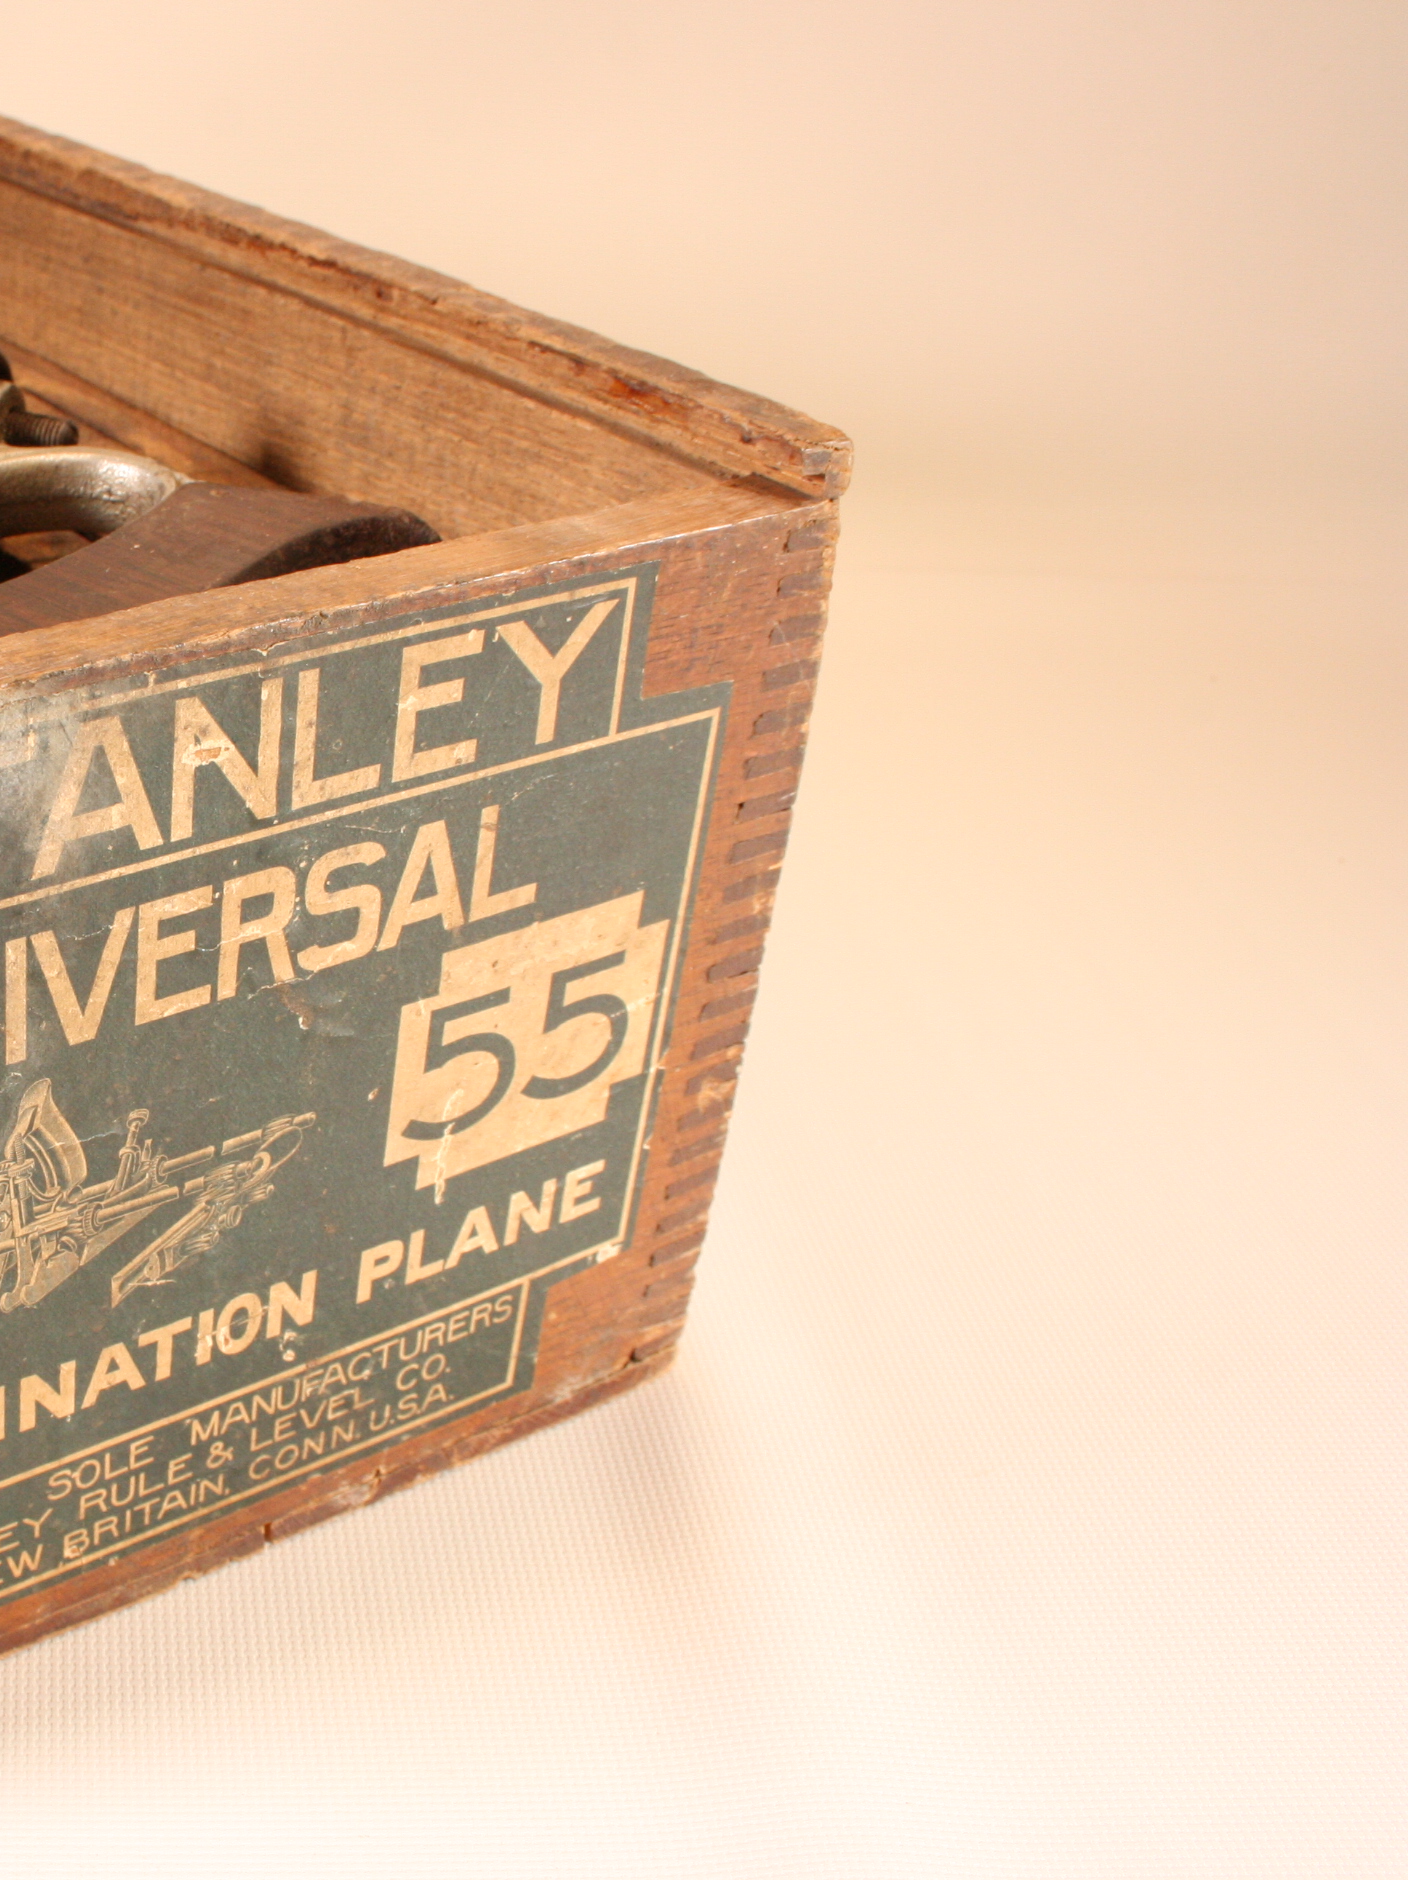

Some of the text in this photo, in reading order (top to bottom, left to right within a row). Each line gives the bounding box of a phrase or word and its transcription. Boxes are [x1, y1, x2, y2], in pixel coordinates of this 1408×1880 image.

[401, 949, 629, 1141] 55
[355, 1159, 606, 1304] PLANE
[47, 1294, 515, 1501] SOLE MANUFACTURERS
[78, 1453, 194, 1520] RULE
[205, 1441, 235, 1469] &
[249, 1387, 376, 1451] LEVEL
[395, 1353, 452, 1392] CO.
[369, 1382, 455, 1432] U.S.A.
